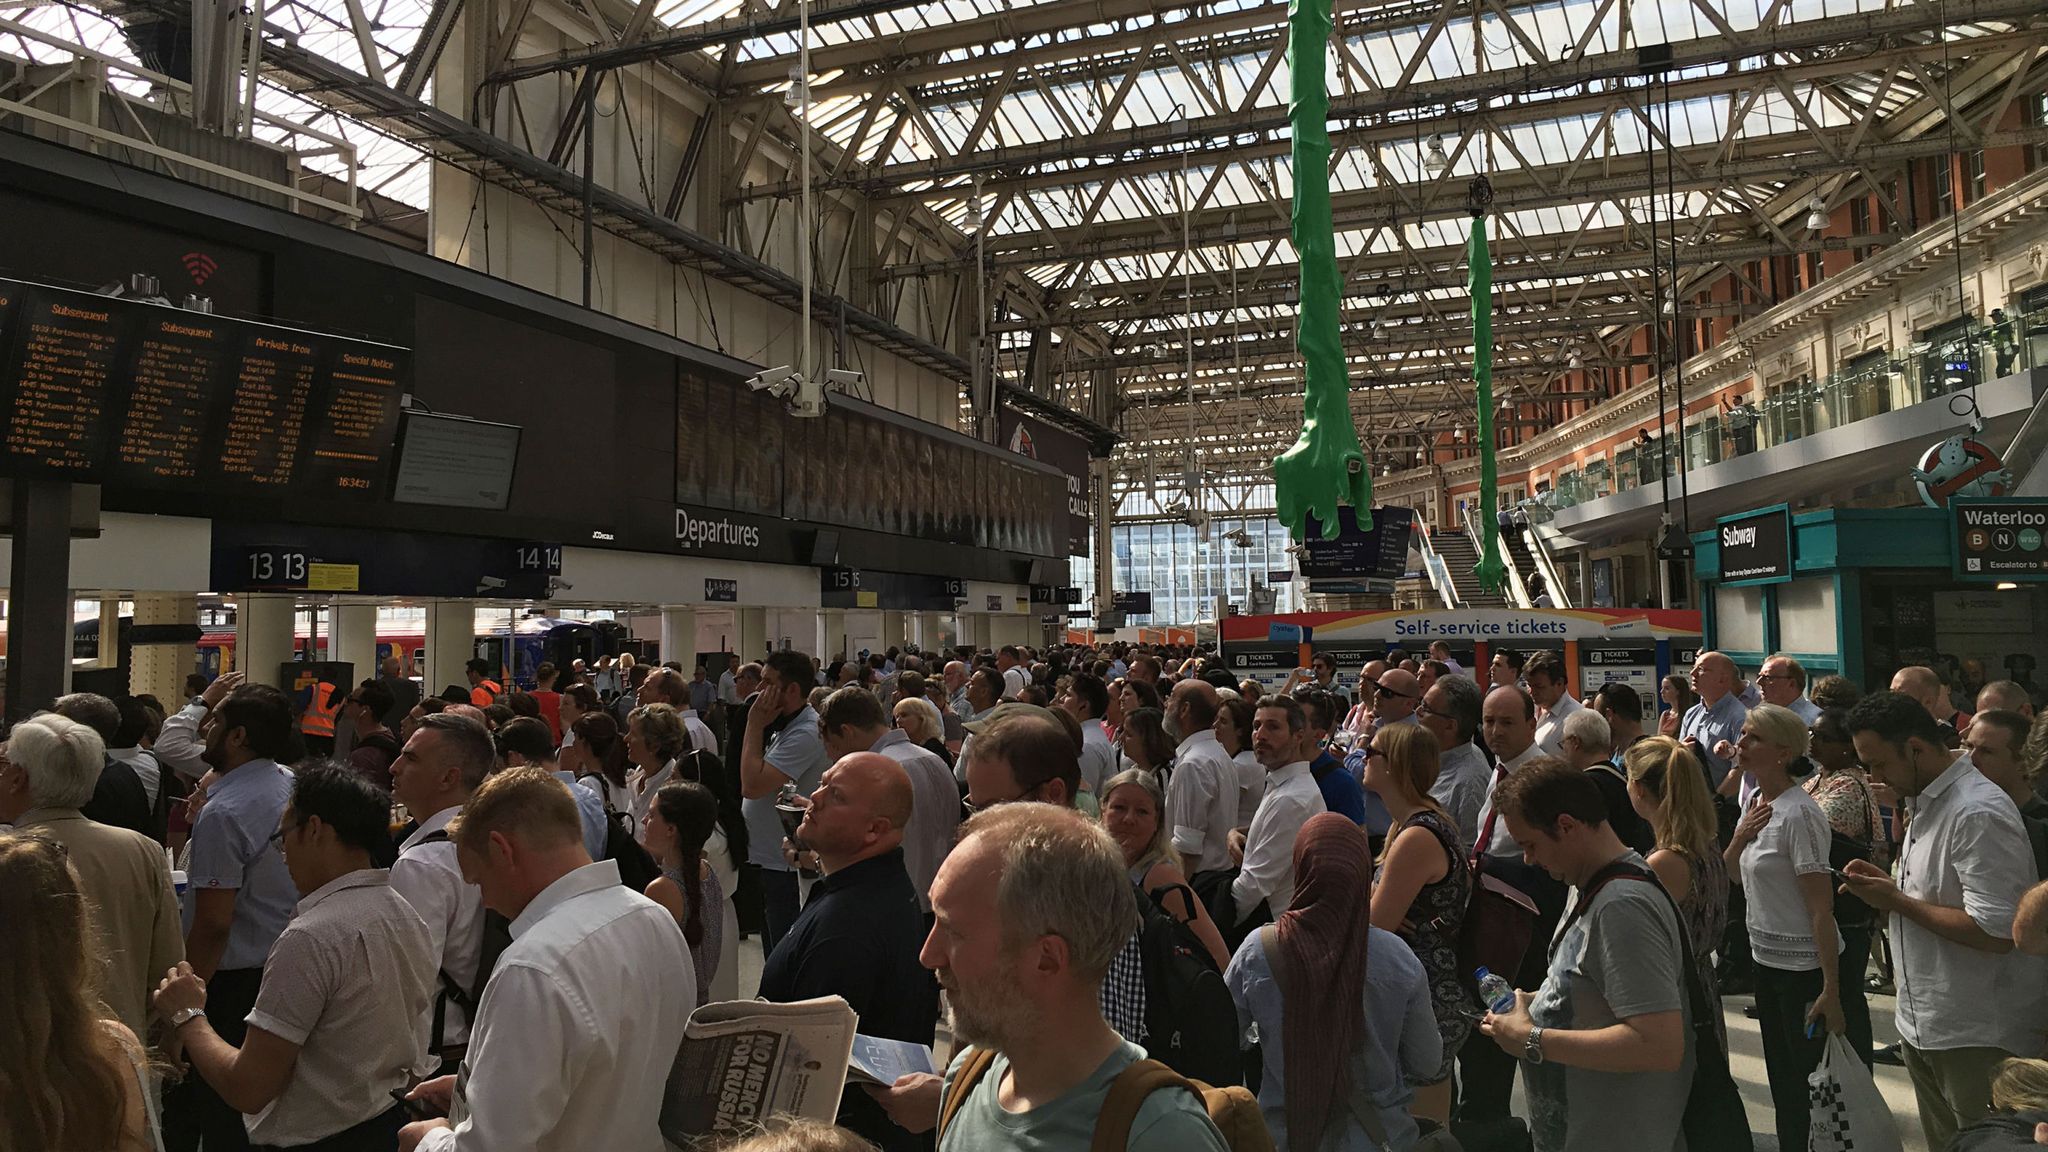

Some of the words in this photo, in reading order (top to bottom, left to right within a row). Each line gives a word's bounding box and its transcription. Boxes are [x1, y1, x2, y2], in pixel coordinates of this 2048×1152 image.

[51, 304, 110, 323] Subsequent
[161, 322, 214, 338] Subsequent
[256, 338, 288, 351] Arrivals
[292, 344, 311, 354] from
[343, 354, 369, 366] Special
[371, 358, 394, 370] Notice
[47, 458, 64, 467] Page
[154, 466, 170, 476] Page
[339, 477, 369, 488] 16:34:21
[1069, 496, 1088, 518] CALL?
[1964, 510, 2046, 525] Waterloo
[676, 508, 759, 548] Departures
[1723, 526, 1756, 548] Subway
[1972, 534, 1983, 545] B
[1998, 534, 2008, 545] N
[249, 553, 273, 580] 13
[282, 553, 305, 580] 13
[517, 548, 540, 569] 14
[546, 548, 560, 569] 14
[833, 572, 849, 587] 15
[852, 572, 860, 587] 15
[944, 581, 959, 594] 16
[1037, 589, 1048, 599] 17
[1066, 591, 1077, 602] 18
[1273, 624, 1295, 632] oyster
[1395, 620, 1500, 635] Self-service
[1507, 618, 1566, 634] tickets
[729, 1036, 754, 1067] FOR
[752, 1035, 775, 1063] NO
[712, 1069, 745, 1130] RUSSIA
